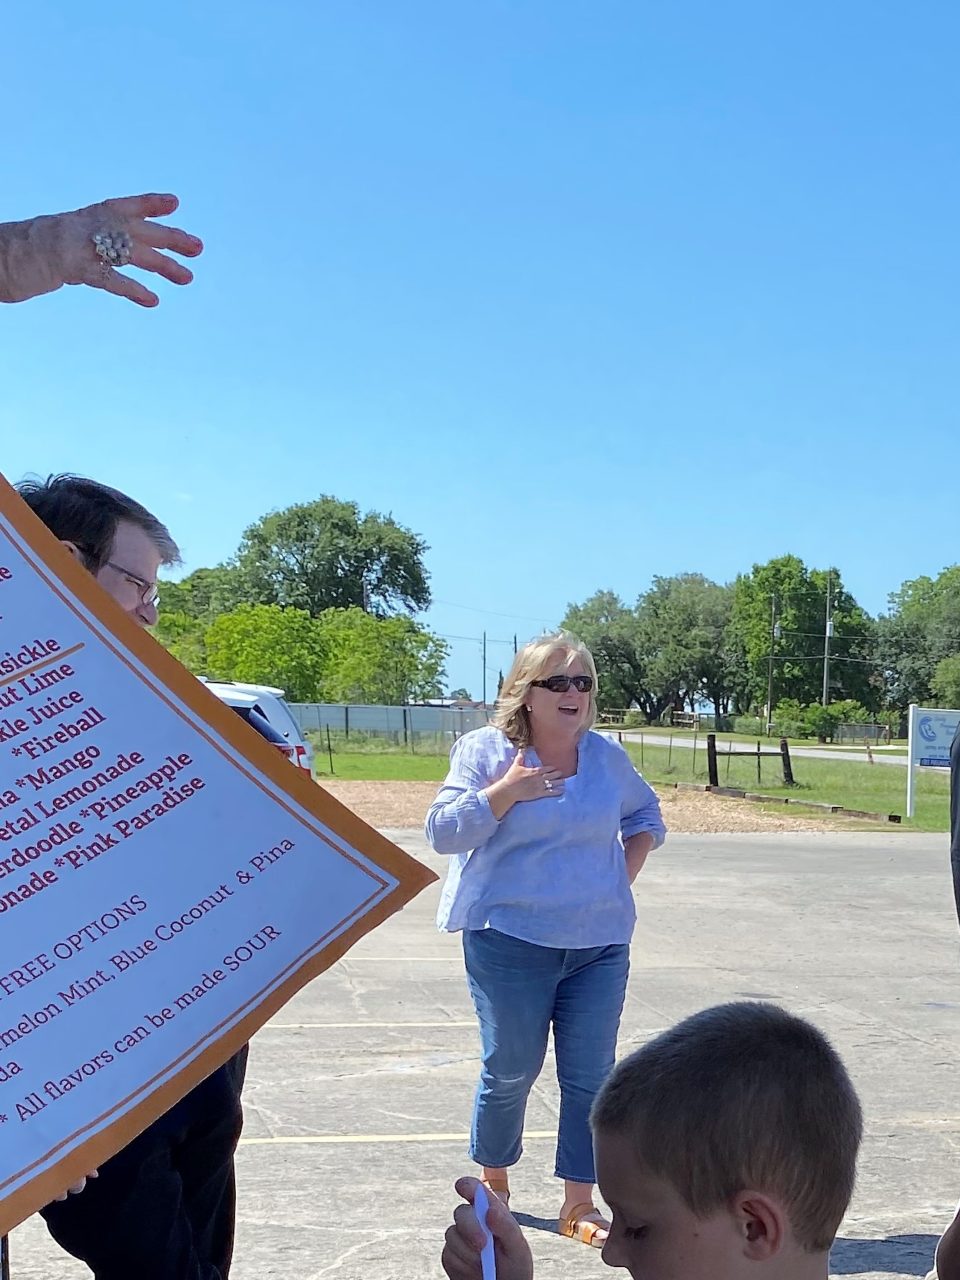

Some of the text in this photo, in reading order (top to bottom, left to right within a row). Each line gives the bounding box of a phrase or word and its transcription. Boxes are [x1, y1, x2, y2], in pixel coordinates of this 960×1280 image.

[0, 638, 61, 676] sickle
[0, 663, 75, 710] ut Lime
[26, 690, 84, 725] Juice
[34, 751, 145, 819] Lemonade
[112, 776, 206, 839] Paradise
[0, 836, 296, 1050] melon Mint, Blue Coconut & Pina
[0, 894, 148, 996] FREE OPTIONS
[15, 923, 283, 1122] All flavors can be made SOUR
